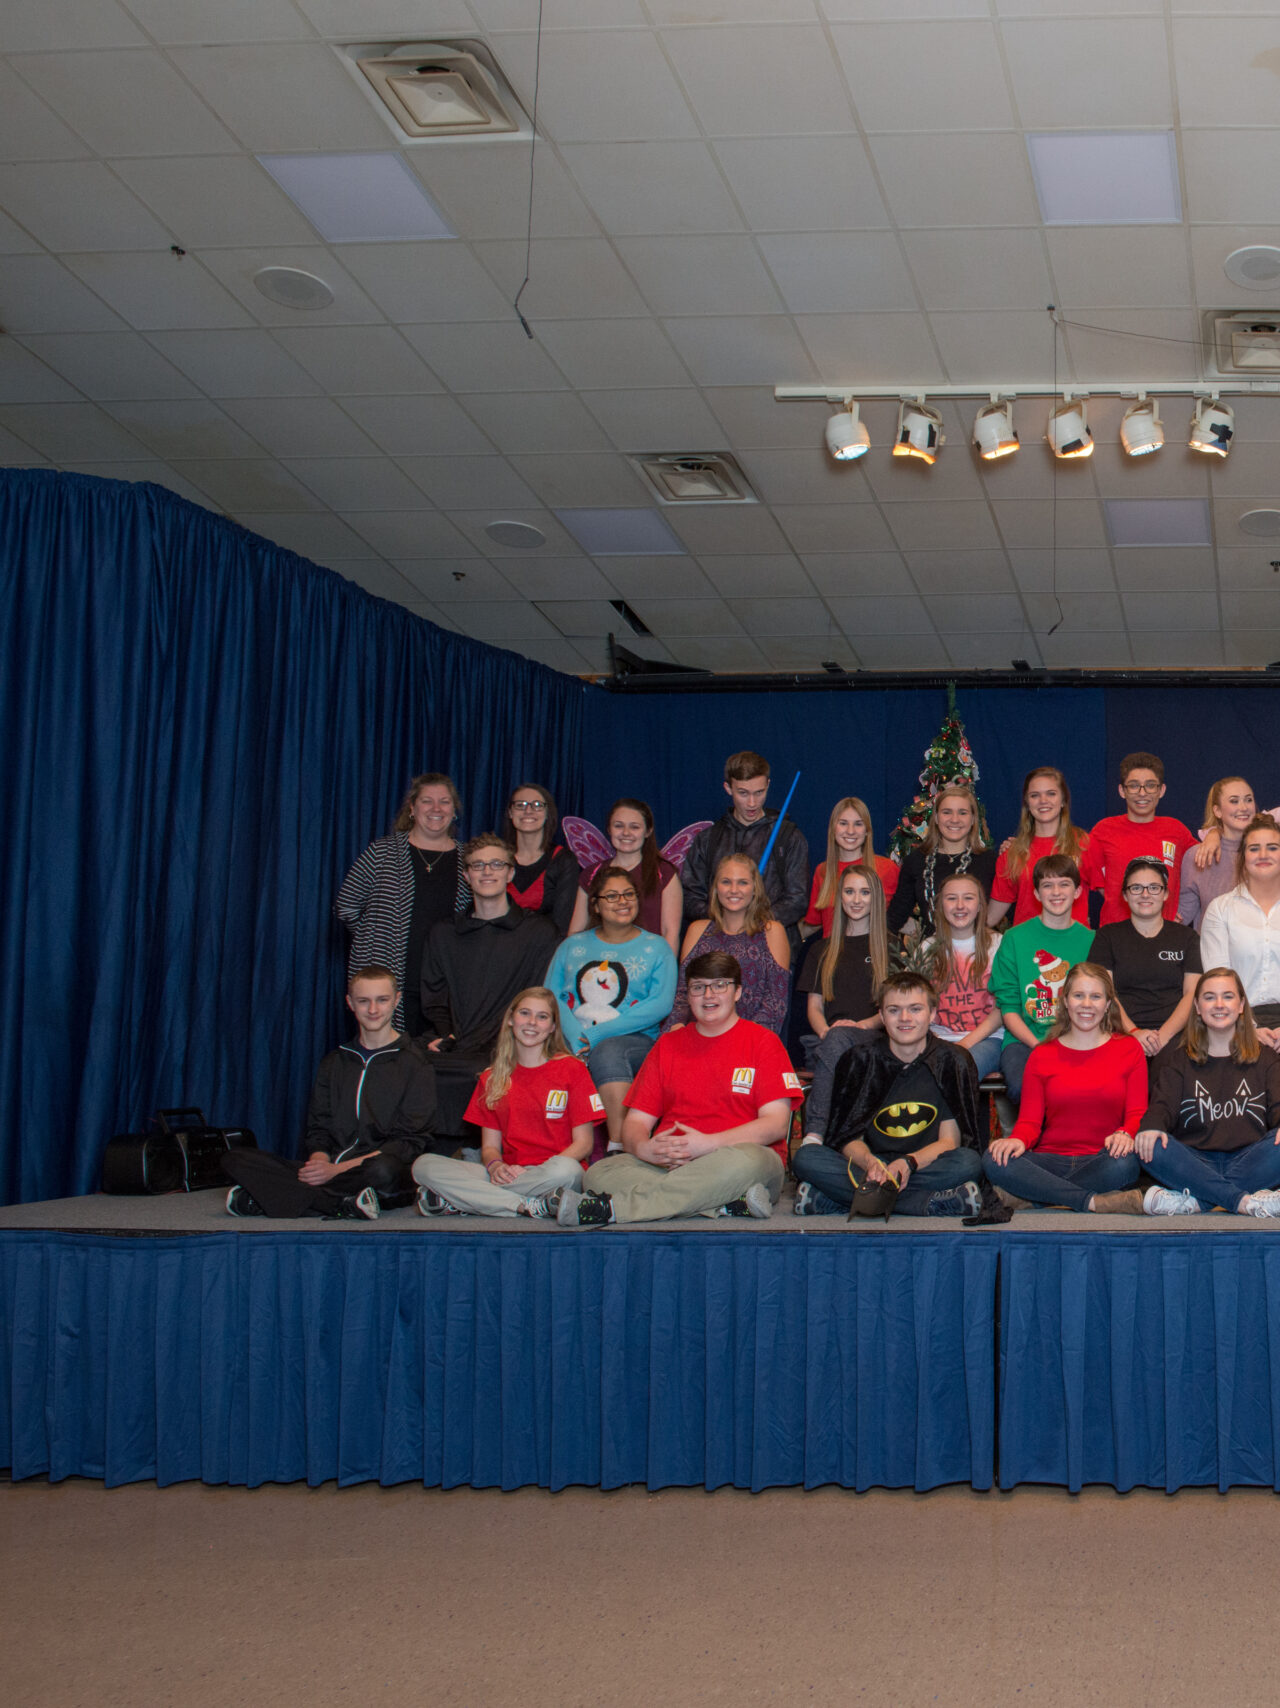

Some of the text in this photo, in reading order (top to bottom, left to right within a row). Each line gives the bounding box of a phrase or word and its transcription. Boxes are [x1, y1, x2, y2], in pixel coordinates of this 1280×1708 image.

[1159, 951, 1184, 960] CRU
[944, 993, 975, 1007] THE
[1199, 1095, 1249, 1124] Meow
